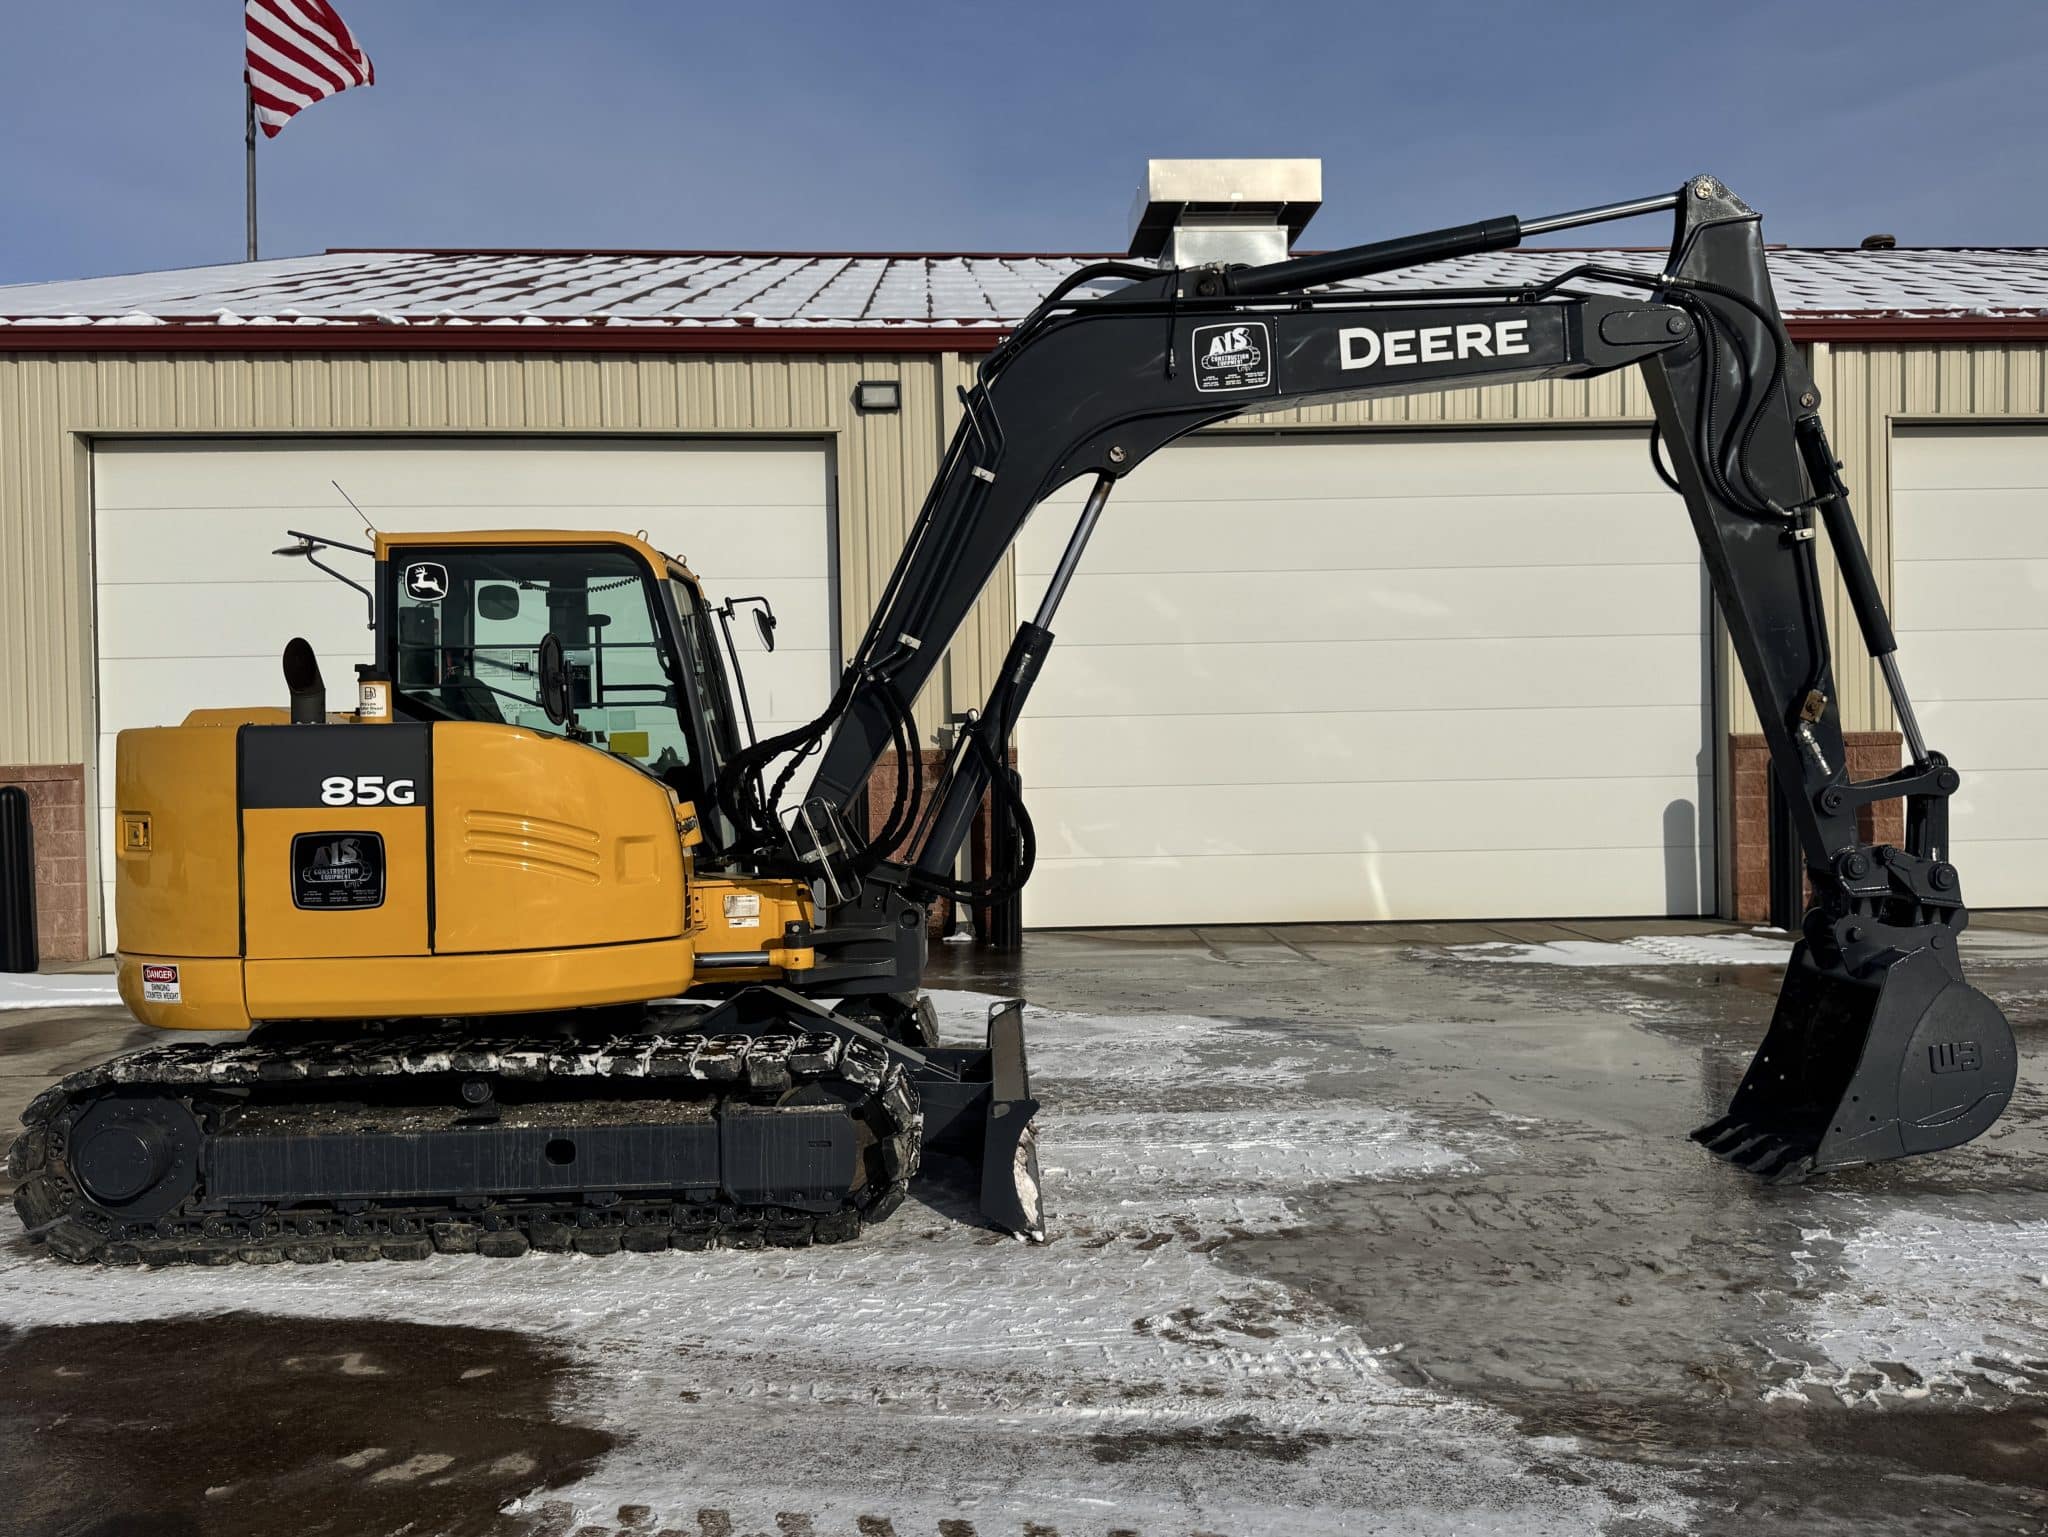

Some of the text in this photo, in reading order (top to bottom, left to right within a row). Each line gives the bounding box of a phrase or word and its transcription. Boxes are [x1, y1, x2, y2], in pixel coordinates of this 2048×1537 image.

[1209, 327, 1250, 356] AIS
[1339, 319, 1530, 370] DEERE
[1210, 353, 1249, 362] CONSTRUCTION
[321, 776, 415, 806] 85G
[314, 868, 359, 876] CONSTRUCTION
[146, 970, 172, 978] DANGER
[146, 991, 162, 999] COUNTER
